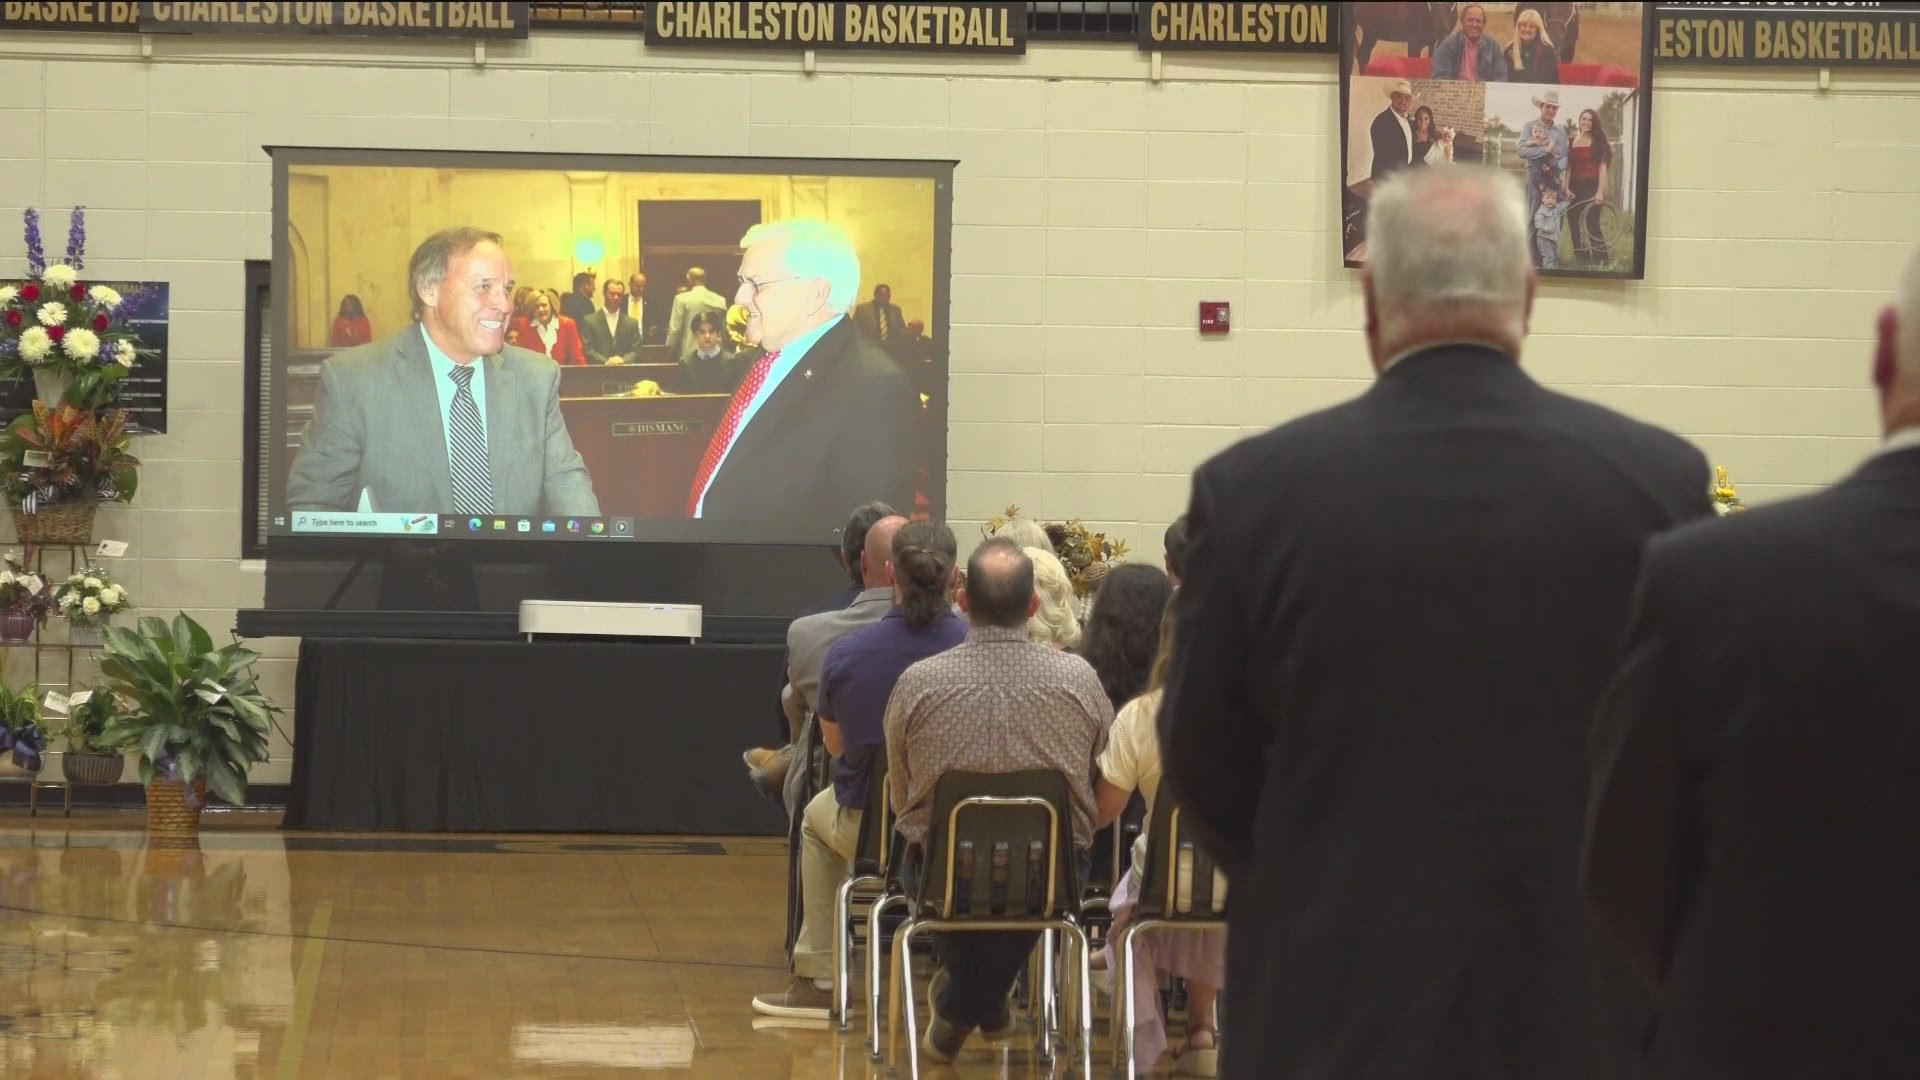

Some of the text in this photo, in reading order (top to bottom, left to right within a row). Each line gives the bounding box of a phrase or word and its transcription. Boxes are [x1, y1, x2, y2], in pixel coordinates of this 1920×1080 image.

[152, 2, 515, 29] CHARLESTON BASKETBALL
[656, 2, 1014, 47] CHARLESTON BASKETBALL
[1150, 2, 1328, 44] CHARLESTON
[1653, 19, 1920, 60] ESTON BASKETBALL
[312, 518, 328, 527] Type
